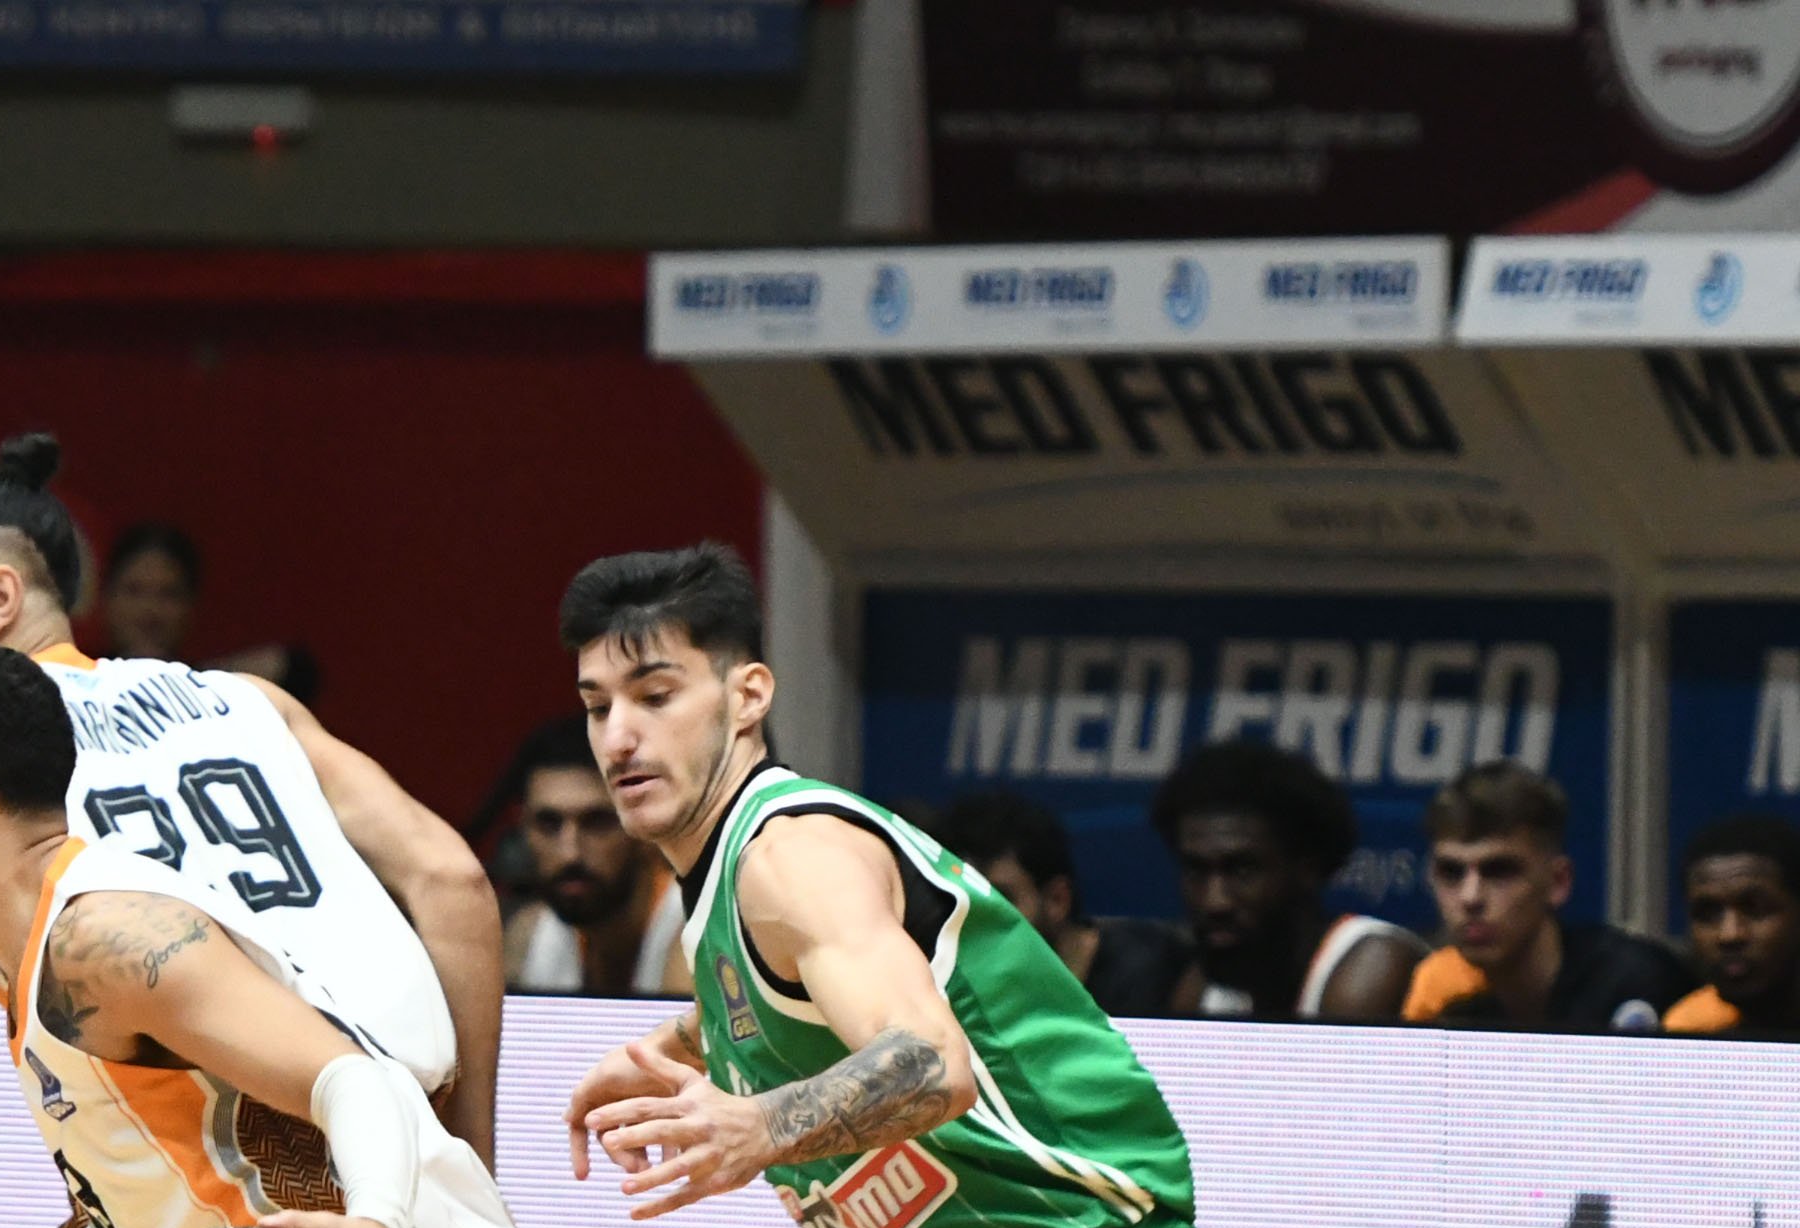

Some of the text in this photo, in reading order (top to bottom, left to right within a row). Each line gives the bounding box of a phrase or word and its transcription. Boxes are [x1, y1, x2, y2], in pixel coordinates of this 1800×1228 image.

[824, 350, 1464, 458] MED FRIGO
[946, 636, 1560, 784] MED FRIGO
